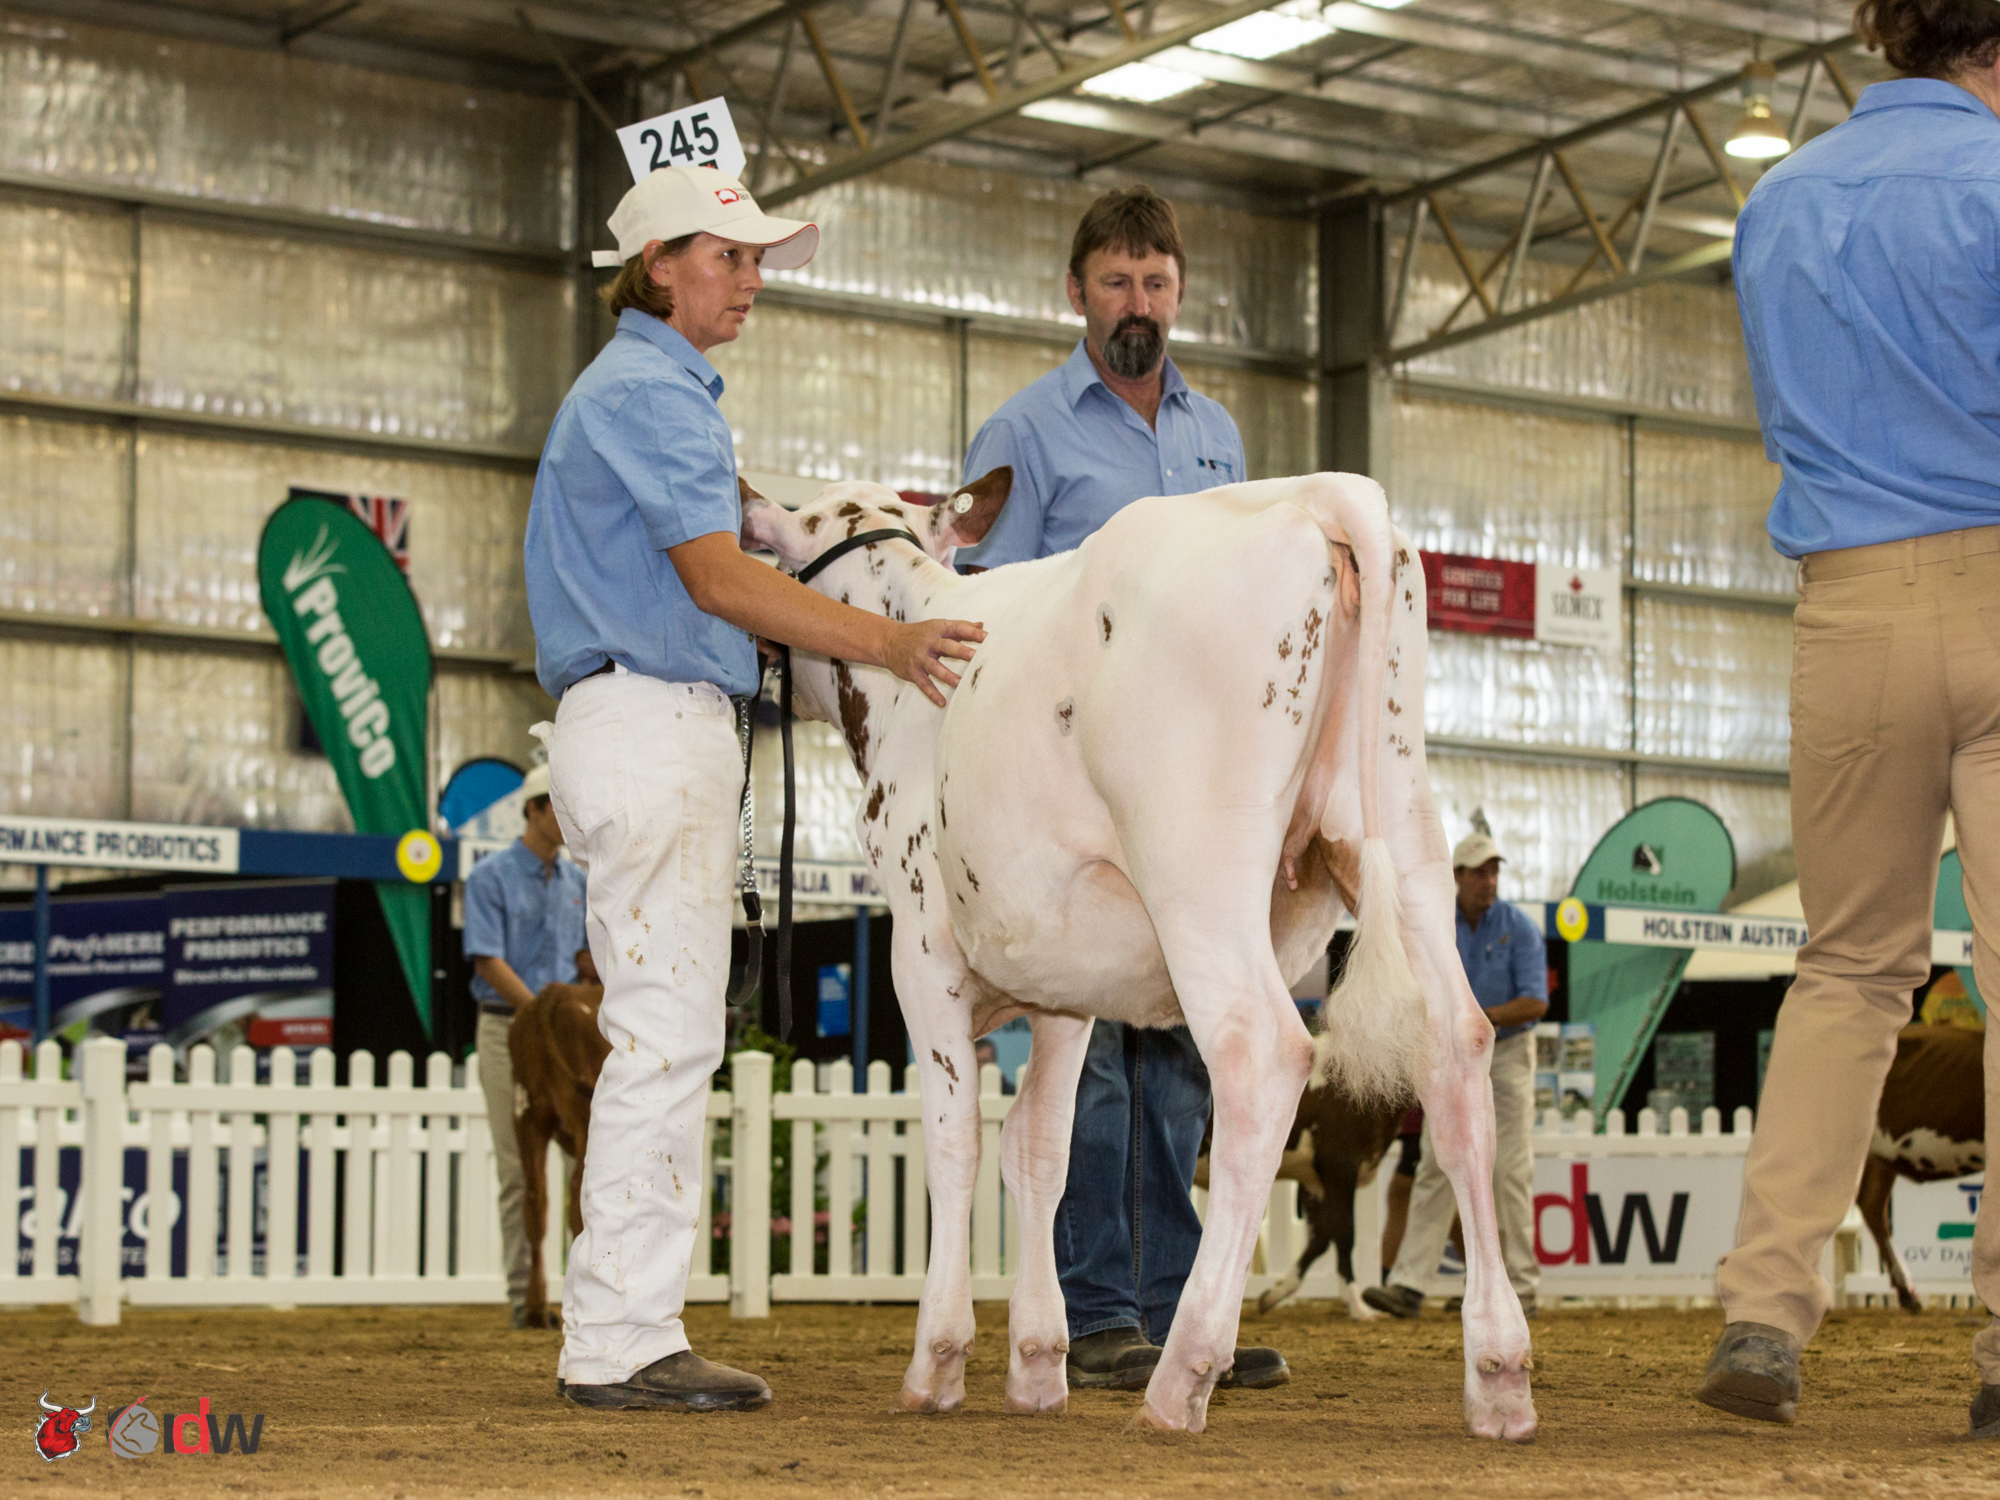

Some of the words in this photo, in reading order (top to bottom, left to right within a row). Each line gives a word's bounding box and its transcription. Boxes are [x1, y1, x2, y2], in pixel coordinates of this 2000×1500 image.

[640, 112, 719, 172] 245
[95, 832, 220, 862] PROBIOTICS
[1598, 879, 1696, 904] Holstein
[169, 912, 327, 939] PERFORMANCE
[1643, 917, 1732, 942] HOLSTEIN
[183, 936, 309, 961] PROBIOTICS
